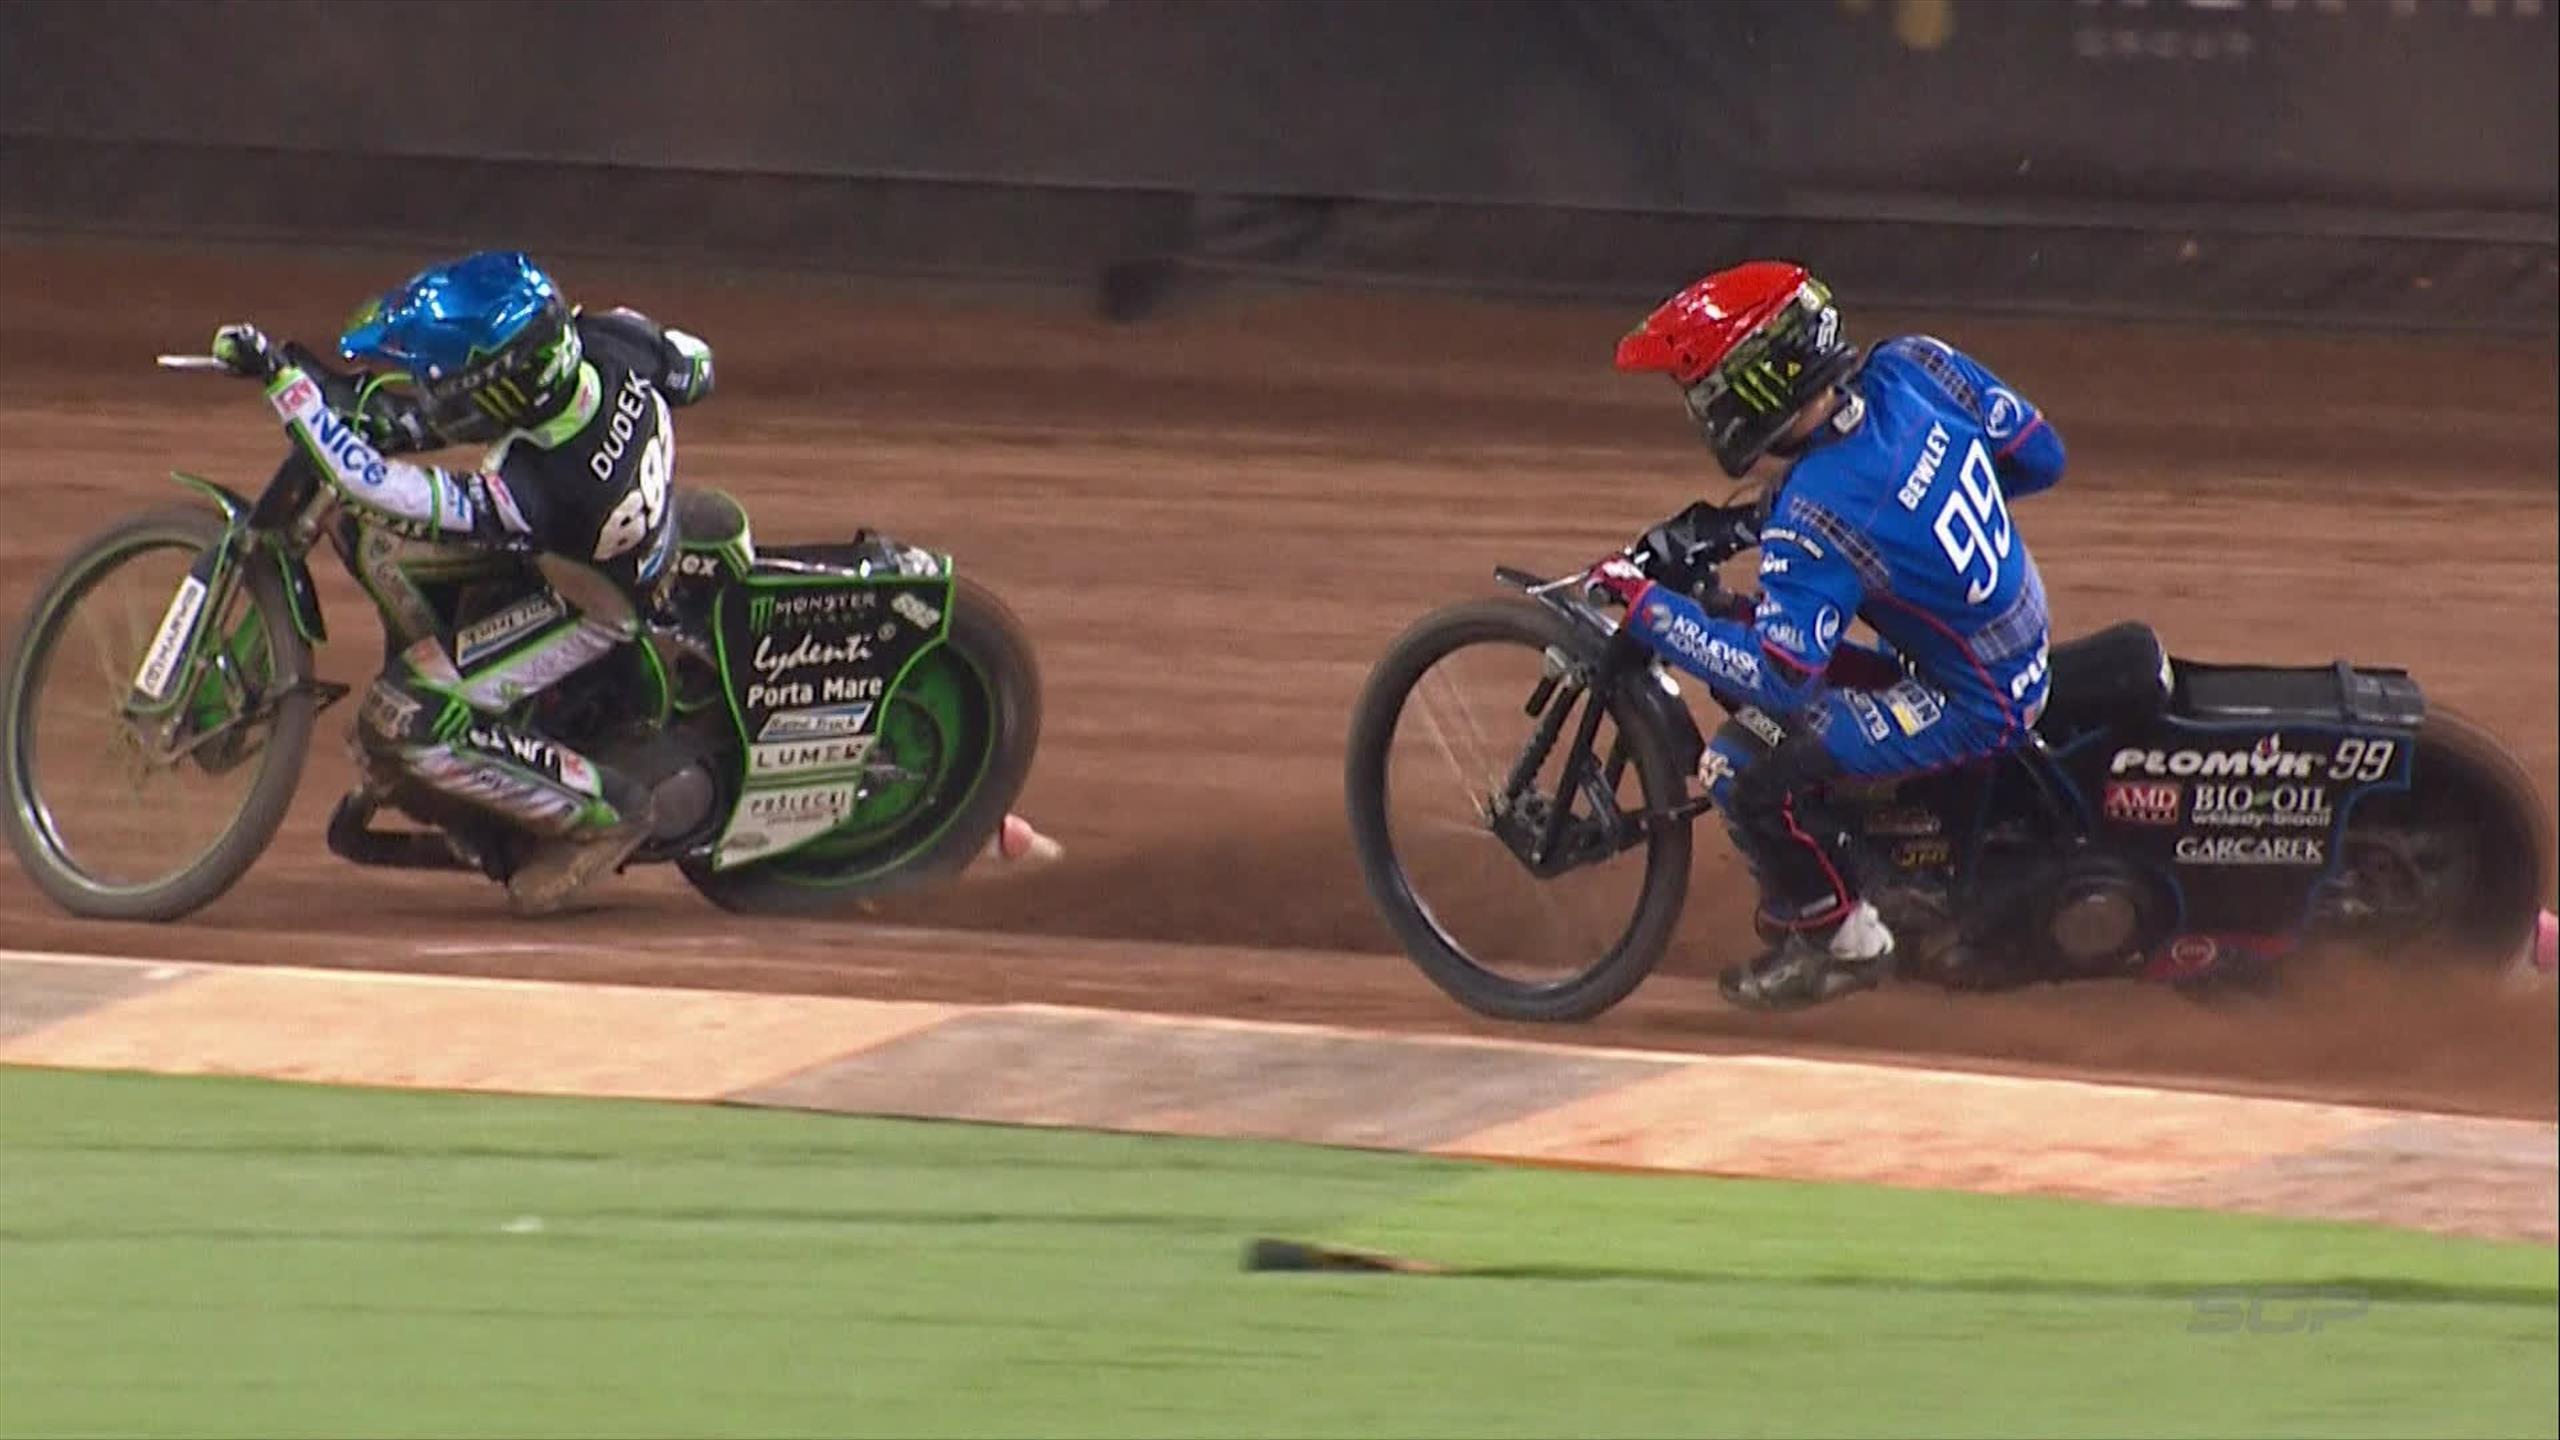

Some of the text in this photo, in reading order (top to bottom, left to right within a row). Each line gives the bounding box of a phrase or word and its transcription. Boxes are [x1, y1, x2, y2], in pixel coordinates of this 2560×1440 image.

[590, 368, 651, 481] DUDEK
[1898, 421, 1951, 511] BEWLEY
[1934, 438, 2010, 603] 99
[775, 593, 877, 613] MONSTER
[747, 676, 883, 709] Porta Mare
[2329, 738, 2395, 782] 99
[2112, 785, 2178, 809] AMD
[2175, 837, 2324, 864] GARCAREK
